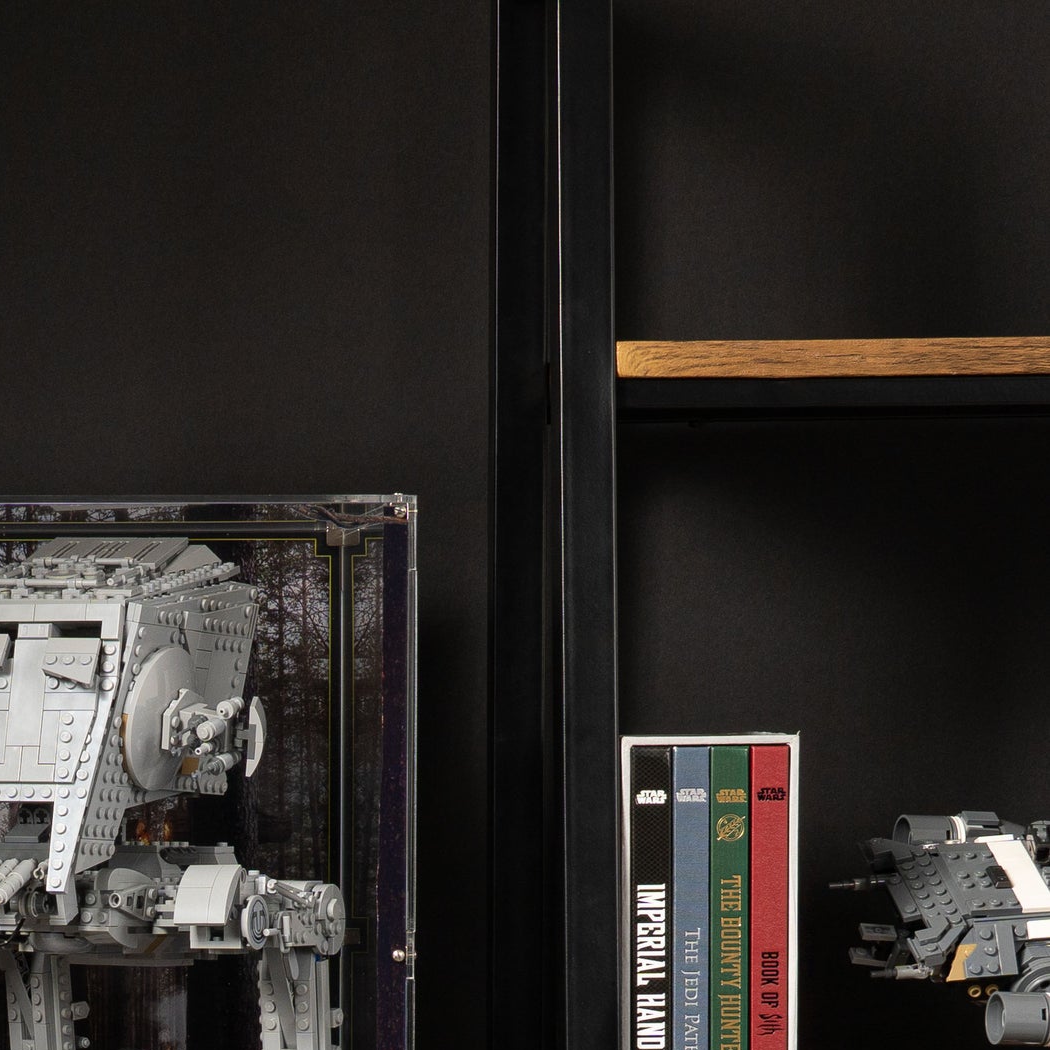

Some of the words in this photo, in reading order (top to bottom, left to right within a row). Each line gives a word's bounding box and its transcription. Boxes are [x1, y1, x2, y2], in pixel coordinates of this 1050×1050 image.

[636, 796, 666, 804] WARS
[637, 790, 667, 798] STAR
[677, 788, 706, 796] STAR
[716, 796, 746, 804] WARS
[757, 787, 786, 795] STAR
[720, 874, 742, 912] THE
[637, 884, 666, 986] IMPERIAL
[684, 927, 700, 964] THE
[720, 916, 742, 990] BOUNTY
[761, 952, 779, 986] BOOK
[681, 970, 700, 1006] JEDI
[761, 992, 779, 1008] OF
